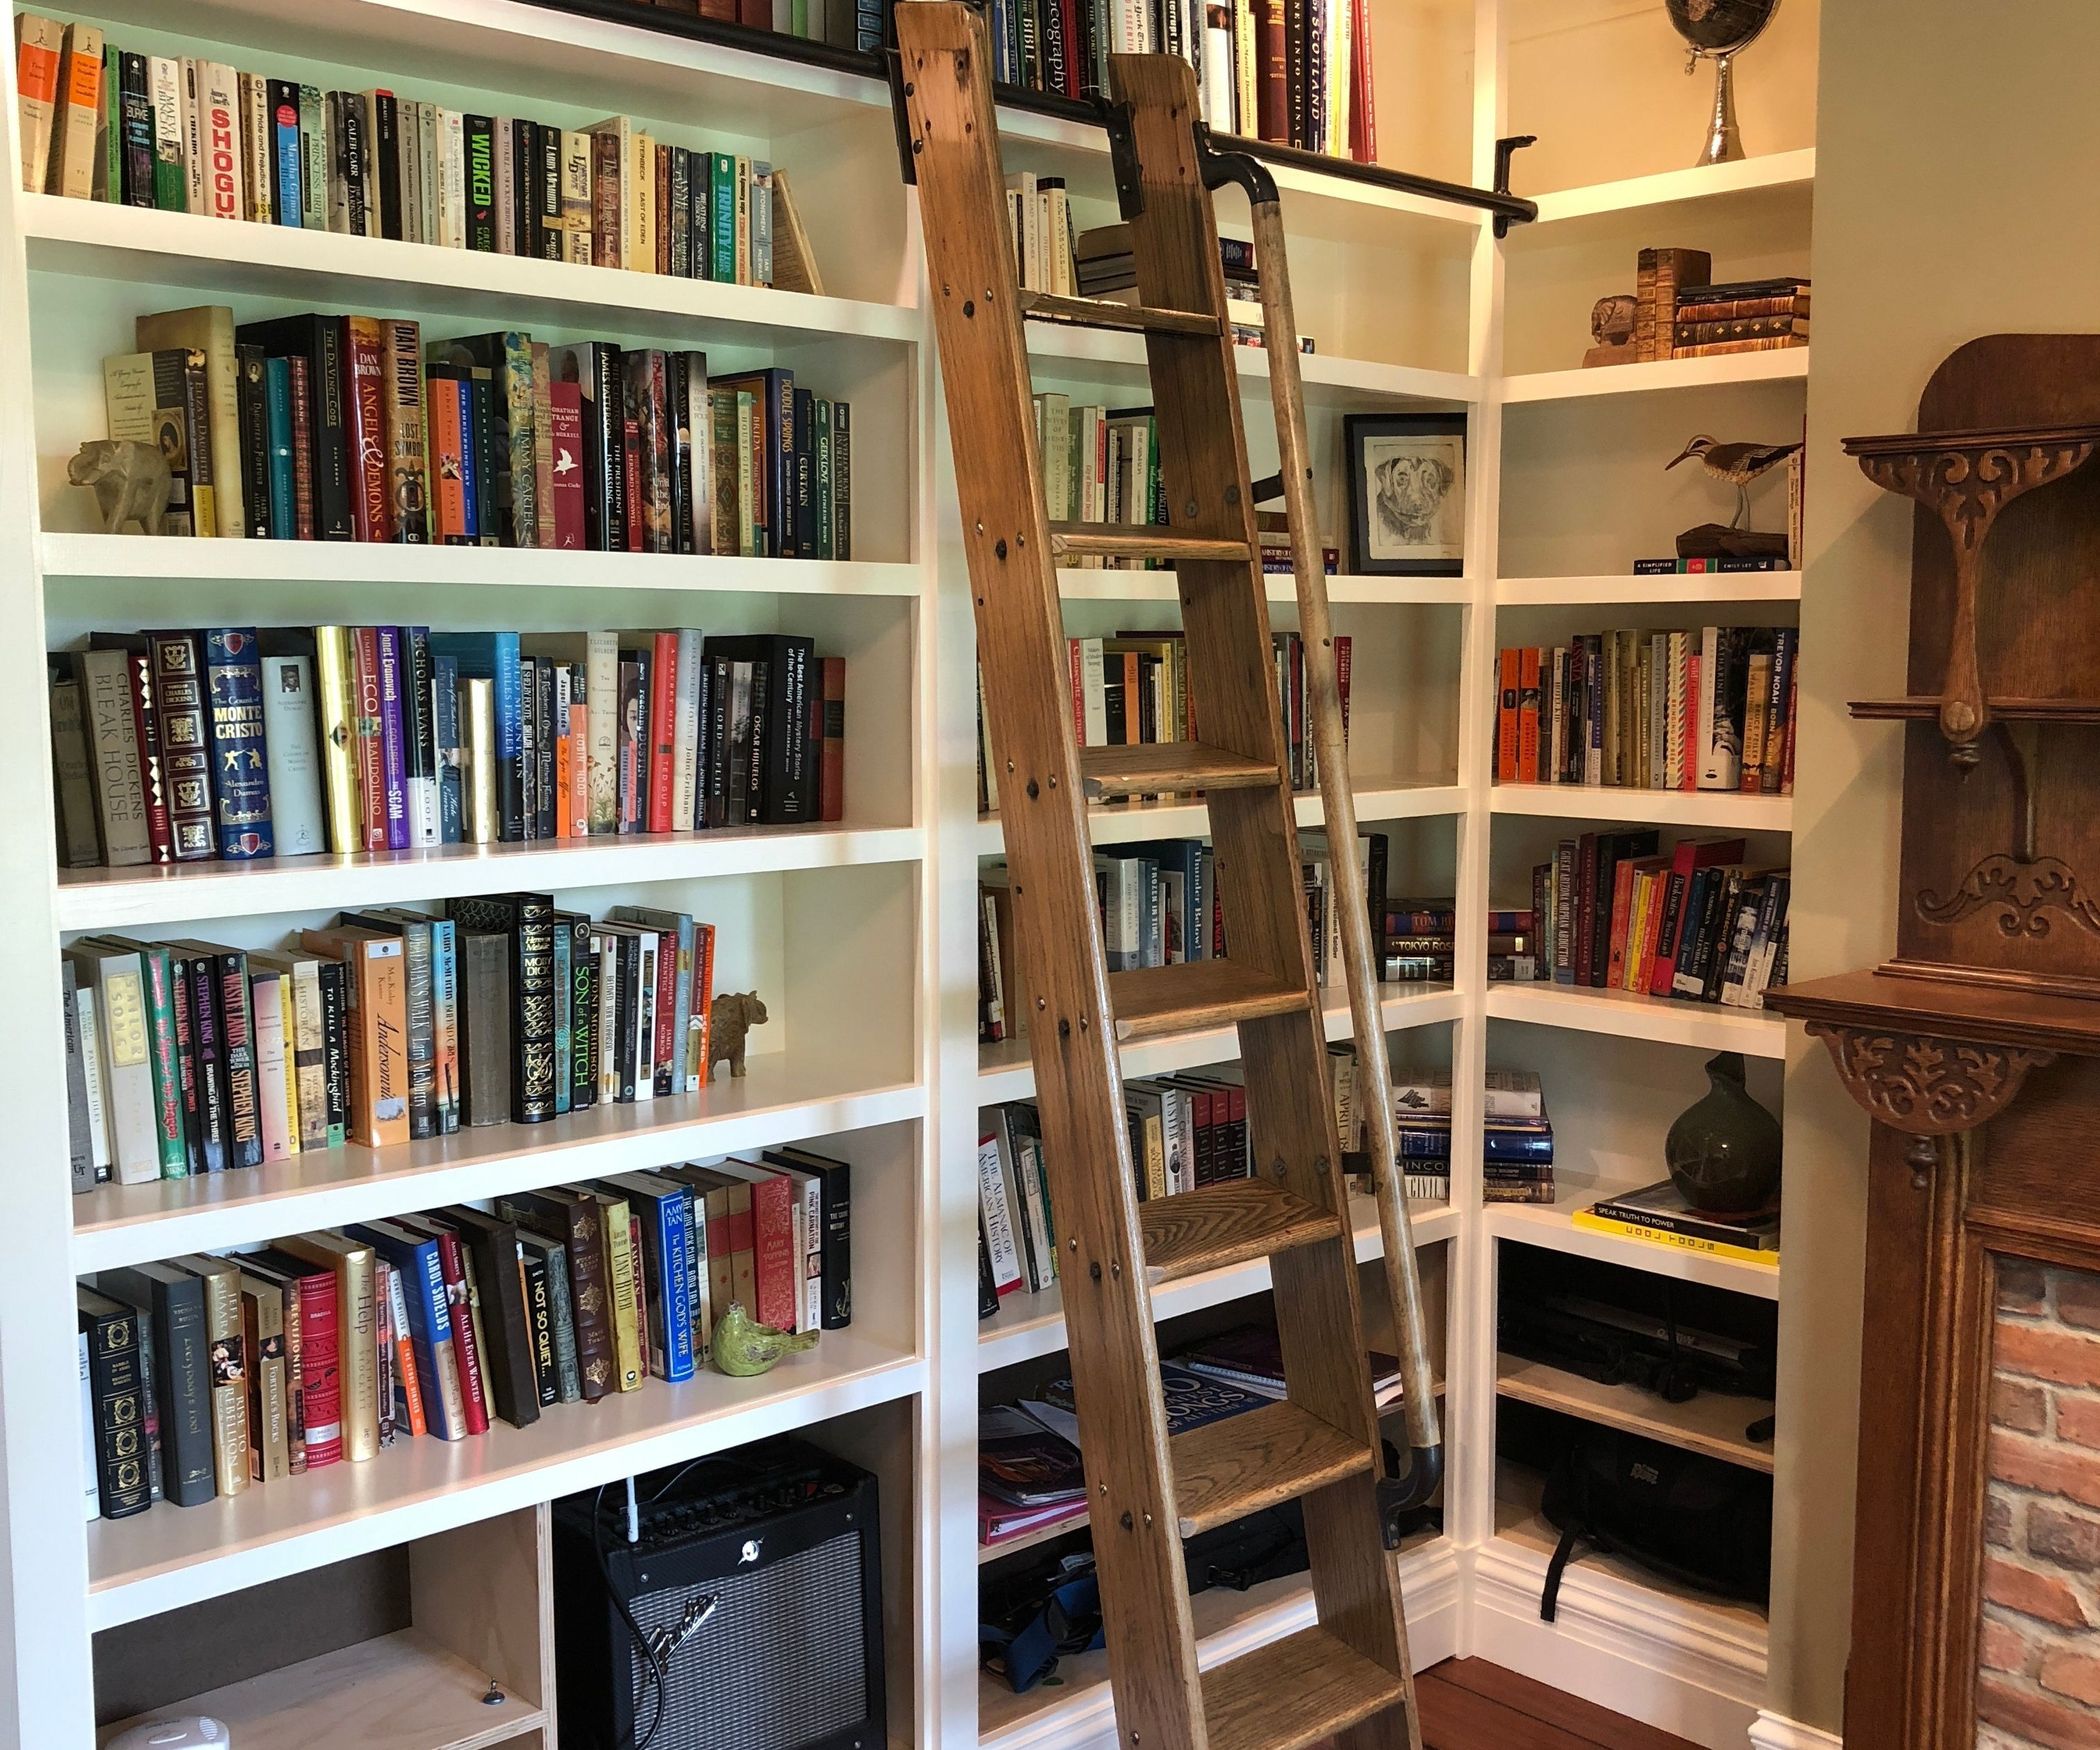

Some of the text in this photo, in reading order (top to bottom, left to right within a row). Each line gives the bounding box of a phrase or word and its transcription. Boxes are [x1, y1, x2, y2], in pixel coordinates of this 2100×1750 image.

[1022, 18, 1036, 63] BIBLE
[1311, 16, 1320, 120] SCOTLAND
[158, 90, 177, 139] MAEVE BINCHY
[211, 108, 236, 220] SHOGU
[258, 152, 266, 189] Prejudice
[347, 119, 359, 176] CALEB CARR
[471, 134, 492, 206] WICKED
[288, 142, 300, 219] Martha Grimes
[311, 138, 322, 225] PRINCESS BRIDE
[759, 189, 767, 236] ATONEMENT
[640, 213, 646, 223] OF
[718, 184, 732, 249] TRINITY
[326, 329, 338, 427] THE DA VINCI CODE
[356, 365, 381, 377] BROWN
[360, 353, 377, 366] DAN
[395, 326, 419, 407] DAN BROWN
[362, 383, 379, 443] ANGELS
[600, 352, 612, 439] JAMES PATTERSON
[781, 379, 794, 453] POODLE SPRINGS
[741, 415, 749, 451] HOUSE
[752, 416, 761, 451] BRIDA
[820, 437, 829, 484] GEEK LOVE
[366, 461, 383, 522] DEMONS
[520, 425, 534, 527] JIMMY CARTER
[606, 463, 614, 504] MISSING
[614, 443, 622, 515] THE PRESIDENT
[799, 457, 809, 507] CURTAIN
[362, 673, 378, 713] ECO
[380, 632, 397, 701] Janet Evanovich
[413, 632, 430, 748] NICHOLAS EVANS
[559, 679, 568, 703] Jasper
[785, 648, 795, 703] of the Century
[1771, 632, 1785, 704] TREVOR NOAH
[213, 706, 262, 723] MONTE
[215, 722, 263, 739] CRISTO
[502, 647, 515, 754] CHARLES FRAZIER
[793, 647, 805, 781] The Best American Mystery Stories
[94, 673, 129, 822] BLEAK HOUSE
[116, 672, 143, 821] CHARLES DICKENS
[575, 733, 586, 796] ROBIN HOOD
[636, 689, 647, 778] reaching DUSTIN
[713, 707, 724, 797] LORD FLIES
[750, 715, 762, 791] OSCAR HIJUELOS
[368, 741, 382, 816] BAUDOLINO
[388, 790, 403, 819] SCAM
[661, 760, 669, 808] TED GUP
[683, 747, 694, 816] John Grisham
[1150, 866, 1158, 941] FROZEN IN TIME
[1193, 850, 1202, 903] Thunder
[1557, 850, 1572, 967] GREAT ARIZONA ORPHAN ABDUCTION
[196, 975, 214, 1044] STEPHEN KING
[327, 987, 335, 1002] TO
[411, 965, 431, 1030] MAN'S WALK
[575, 966, 589, 1005] SON
[577, 1007, 587, 1017] of
[328, 1005, 337, 1033] KILL
[590, 976, 599, 1082] TONI MORRISON
[329, 1048, 343, 1112] Mockingbird
[408, 1037, 432, 1108] Larry McMurtry
[575, 1024, 588, 1088] WITCH
[230, 1069, 256, 1143] STEPHEN KING
[807, 1191, 817, 1250] PINK CARNATION
[979, 1152, 1004, 1264] AMERICAN HISTORY
[987, 1148, 1013, 1256] THE ALMANAC OF
[1411, 1178, 1437, 1198] CIVIL
[1598, 1207, 1674, 1228] SPEAK TRUTH TO POWER
[216, 1283, 228, 1338] SHAARA
[227, 1292, 238, 1321] JEFF
[353, 1294, 372, 1335] Help
[425, 1252, 450, 1332] CAROL SHIELDS
[672, 1247, 689, 1358] KITCHEN GOD'S WIFE
[459, 1313, 481, 1403] ALL HE EVER WANTED
[533, 1280, 551, 1378] NOT SO QUIET...
[224, 1387, 239, 1468] REBELLION
[235, 1395, 248, 1453] RISE TO
